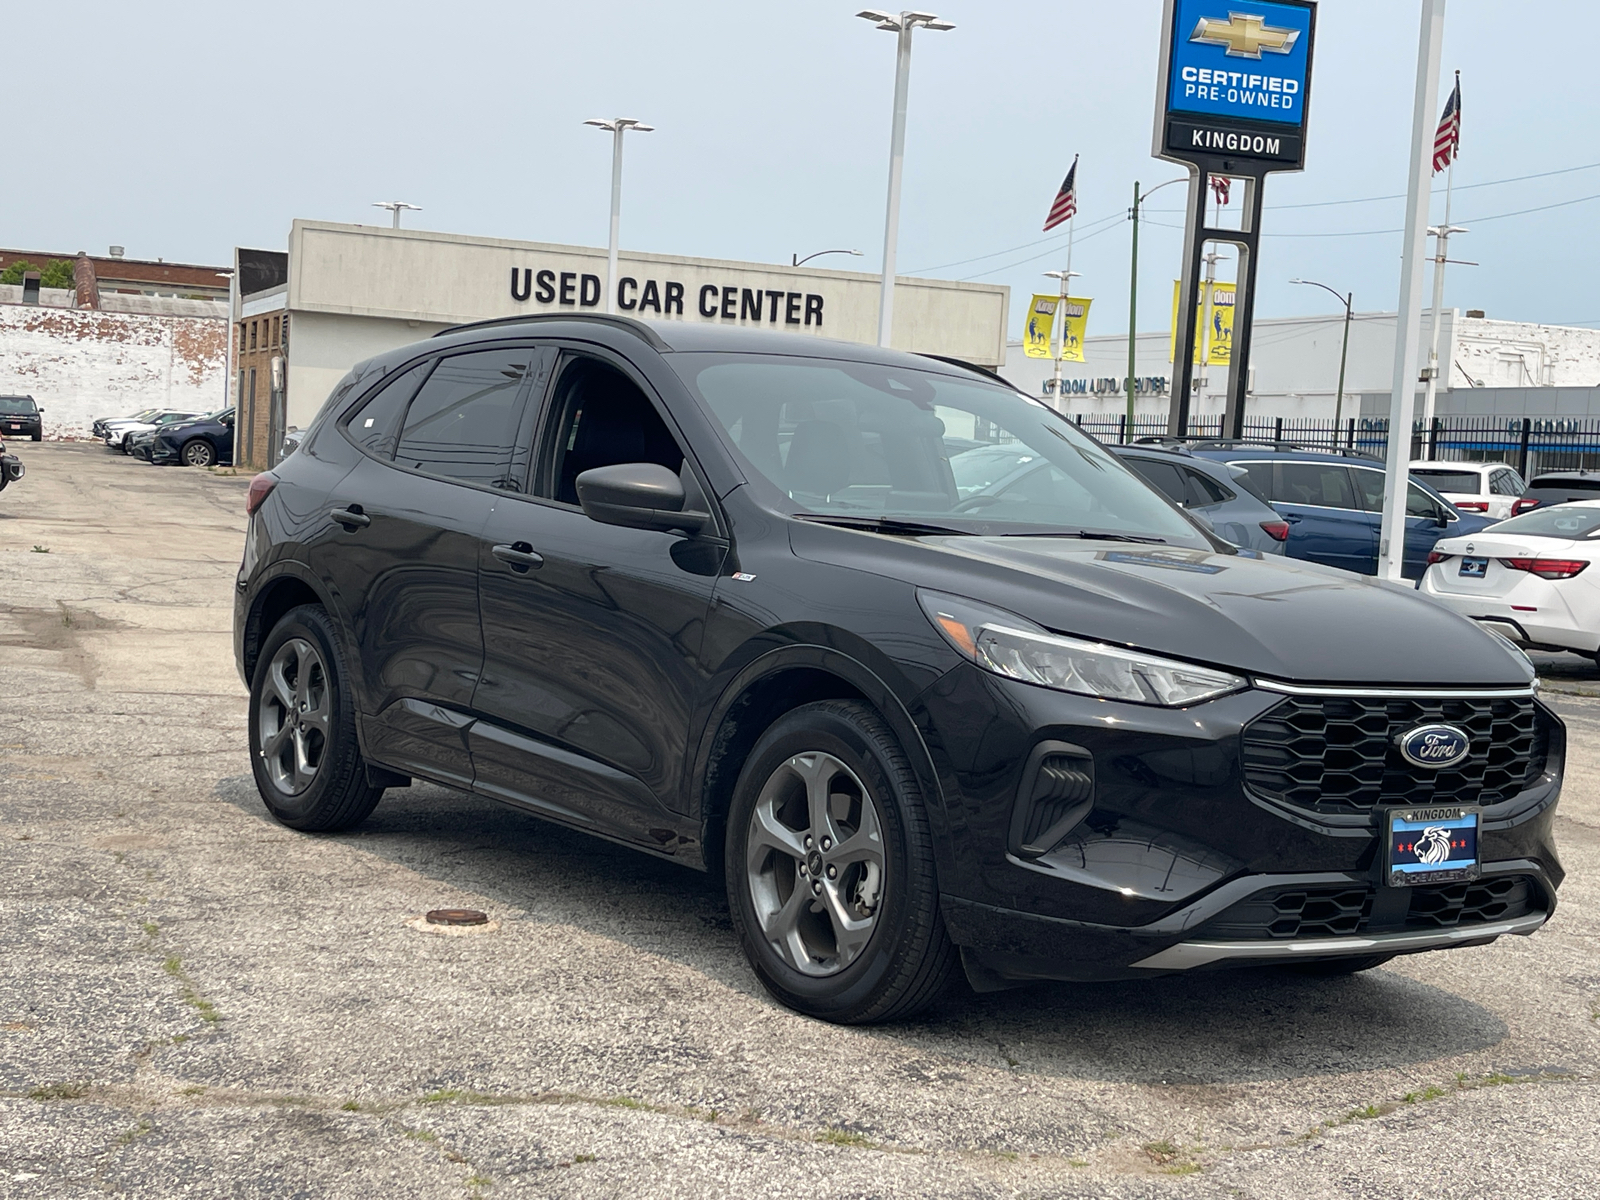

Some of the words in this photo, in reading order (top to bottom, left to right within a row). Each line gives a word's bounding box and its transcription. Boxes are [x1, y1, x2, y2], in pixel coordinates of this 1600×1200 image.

[1181, 66, 1299, 95] CERTIFIED
[1185, 83, 1293, 110] PRE-OWNED
[1192, 129, 1280, 155] KINGDOM
[511, 267, 601, 307] USED
[618, 276, 684, 315] CAR
[699, 284, 824, 326] CENTER
[1034, 299, 1056, 315] King
[1419, 733, 1457, 758] Ford
[1411, 807, 1462, 821] KINGDOM
